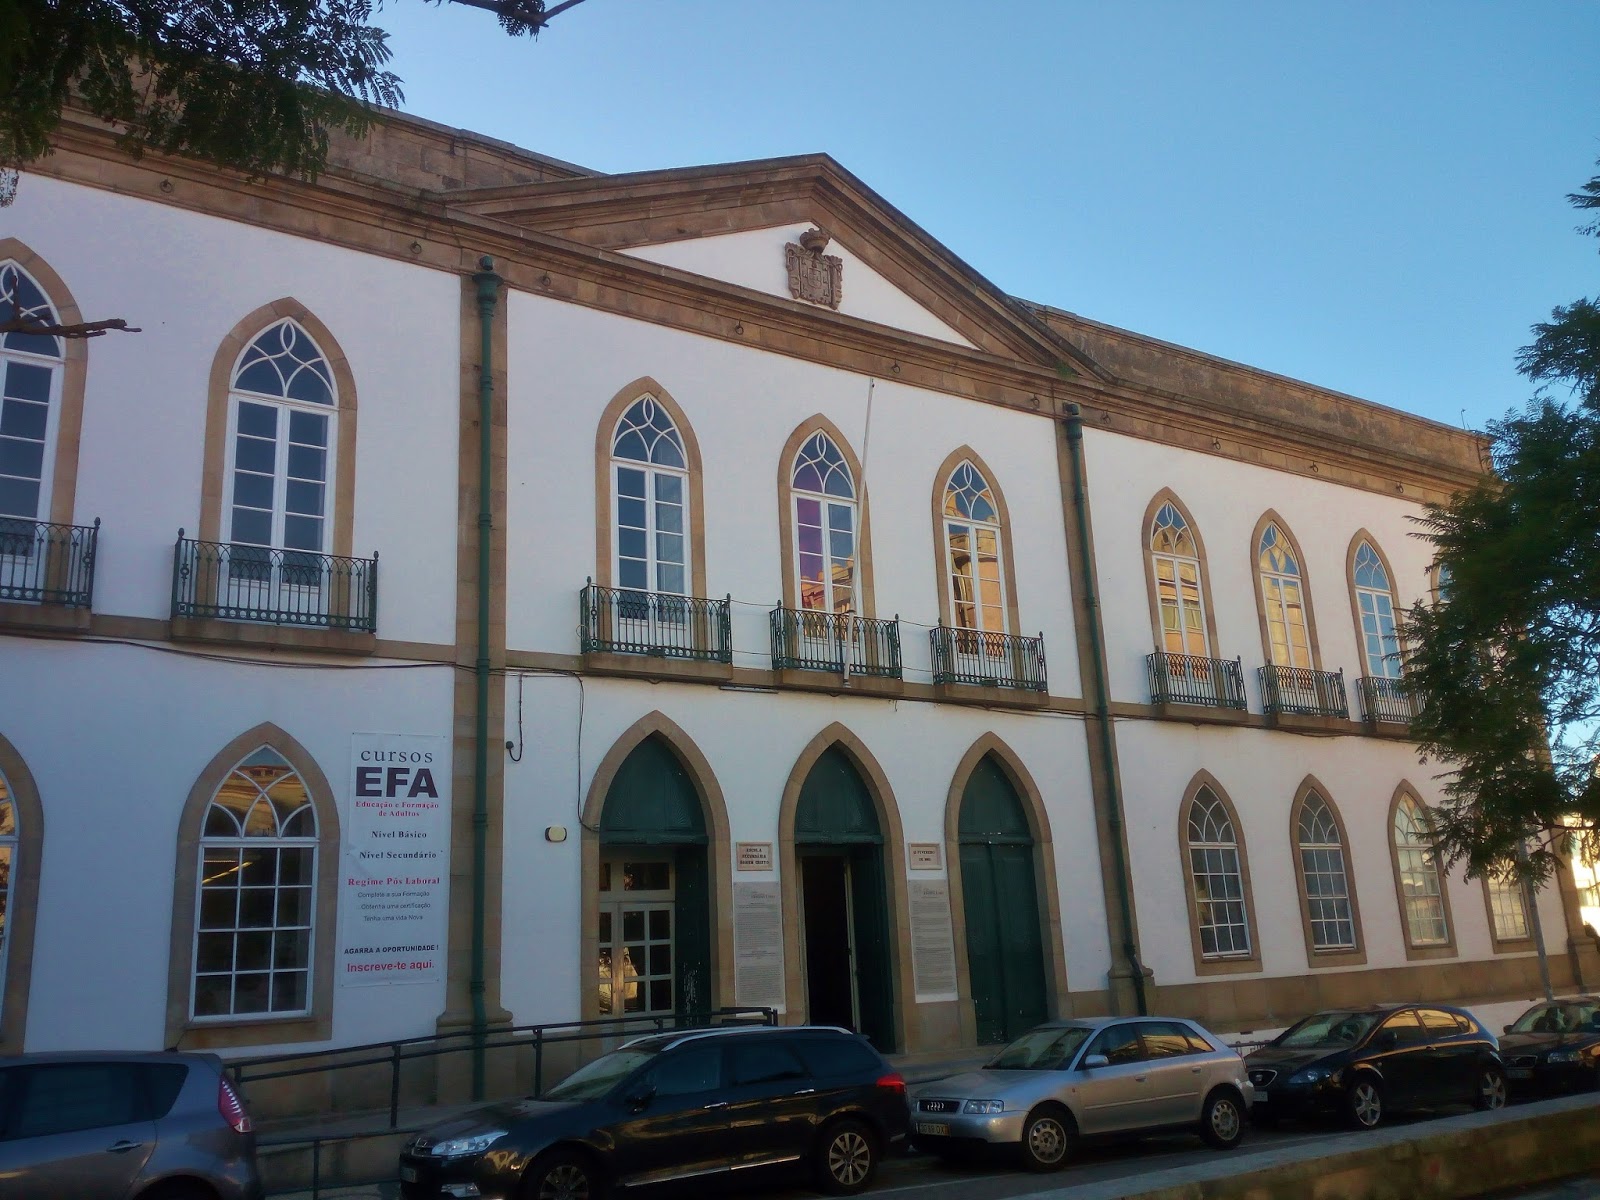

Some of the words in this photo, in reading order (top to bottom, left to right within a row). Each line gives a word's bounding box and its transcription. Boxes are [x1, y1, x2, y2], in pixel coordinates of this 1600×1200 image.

[356, 767, 439, 798] EFA
[356, 801, 392, 809] Educação
[402, 801, 439, 809] Formação
[398, 830, 427, 838] Básico
[386, 851, 437, 859] Secundário
[348, 878, 383, 887] Regime
[387, 877, 403, 885] Pós
[405, 877, 440, 885] Laboral
[344, 947, 374, 955] AGARRA
[347, 961, 407, 973] Inscreve-te
[409, 959, 435, 971] aqui.
